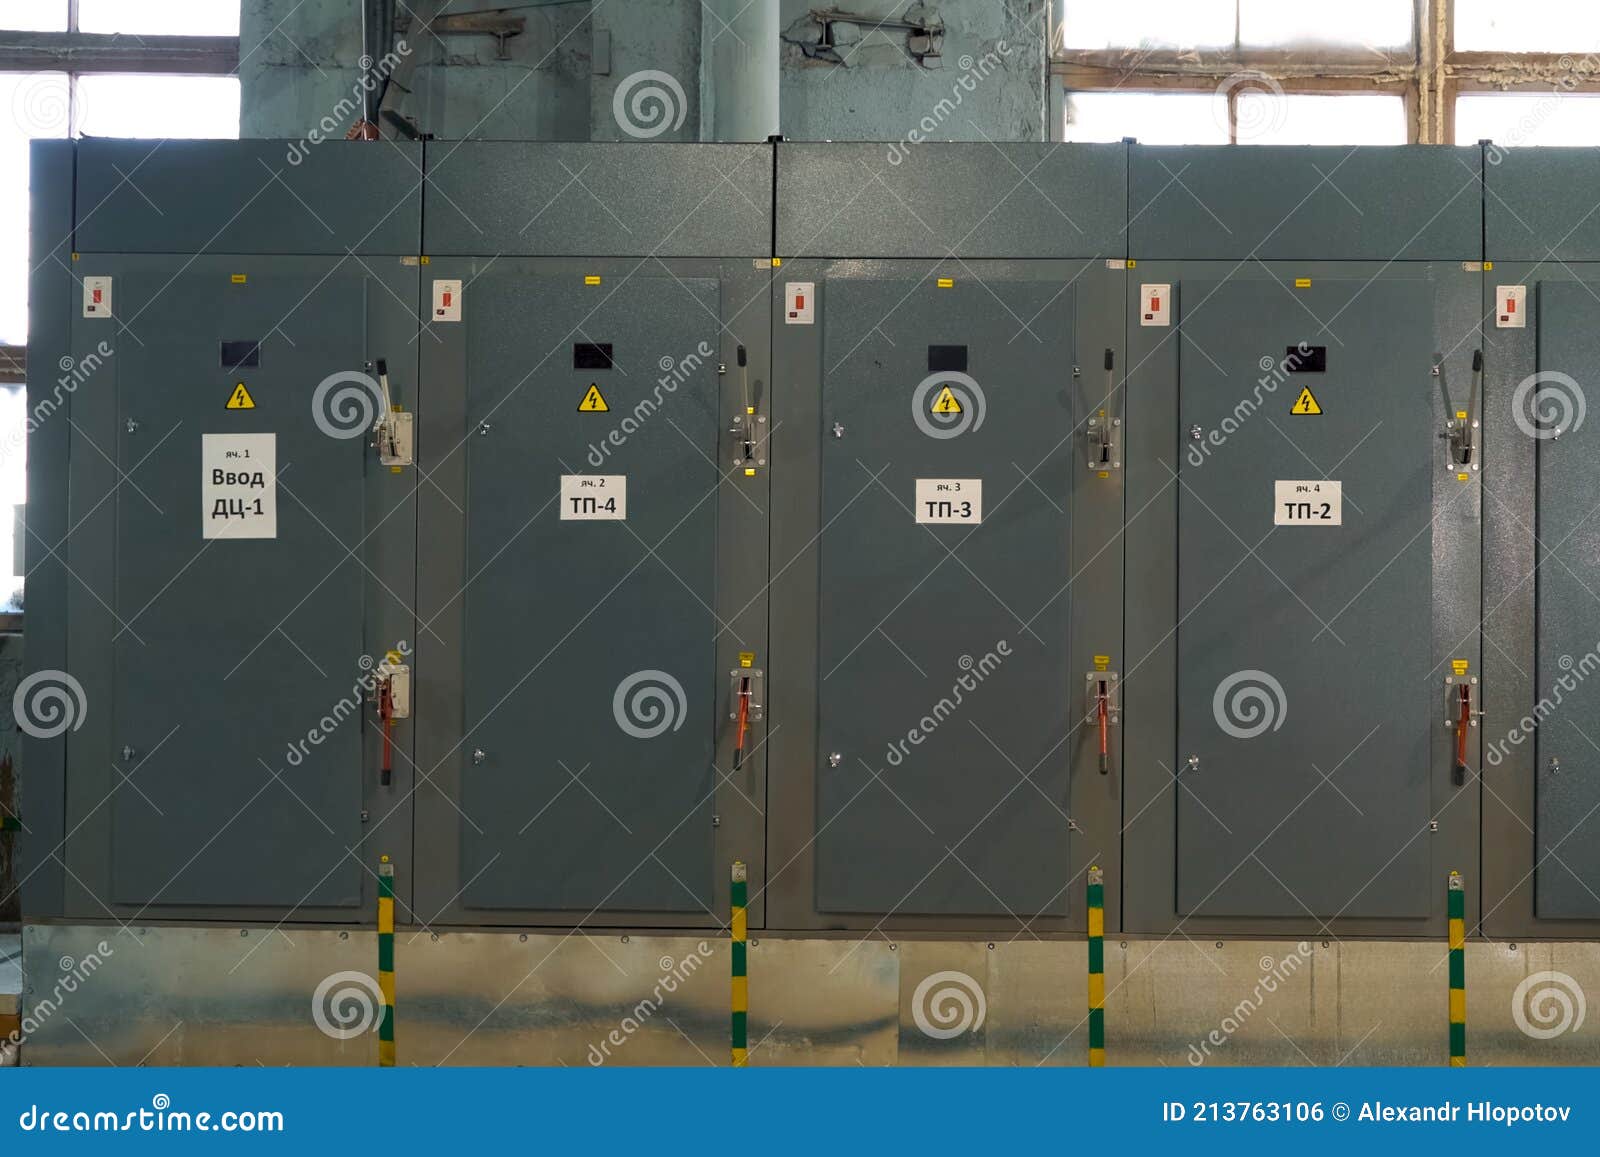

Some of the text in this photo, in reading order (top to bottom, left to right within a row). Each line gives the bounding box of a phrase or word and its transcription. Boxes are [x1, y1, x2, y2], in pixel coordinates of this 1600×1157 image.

[225, 449, 250, 459] яч. 1
[212, 468, 265, 489] Ввод
[599, 478, 605, 488] 2
[954, 482, 961, 492] 3
[1313, 484, 1320, 493] 4
[211, 498, 264, 519] ДЦ-1
[569, 497, 617, 514] ТП-4
[925, 501, 972, 518] ТП-3
[1284, 502, 1332, 519] ТП-2
